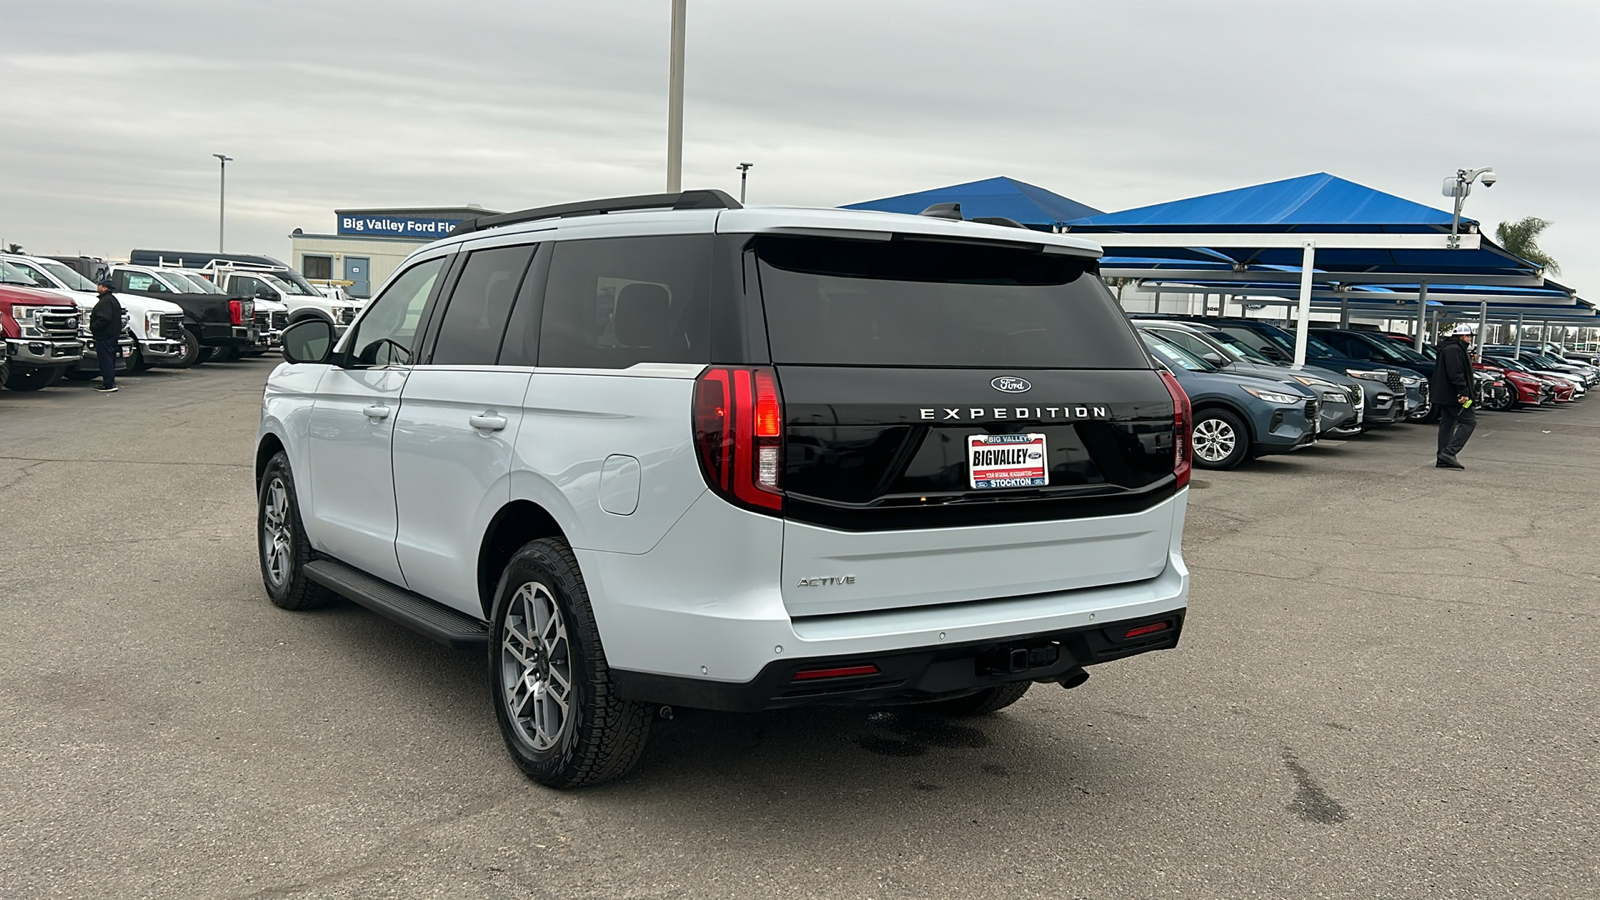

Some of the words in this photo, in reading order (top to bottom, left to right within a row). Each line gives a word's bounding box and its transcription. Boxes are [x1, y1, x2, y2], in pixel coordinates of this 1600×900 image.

[343, 218, 364, 230] Big
[367, 219, 405, 233] Valley
[407, 220, 435, 232] Ford
[1000, 378, 1024, 391] Ford
[920, 407, 1106, 420] EXPEDITION
[973, 448, 1028, 466] BIGVALLEY
[990, 477, 1031, 488] STOCKTON
[797, 574, 856, 587] ACTIVE
